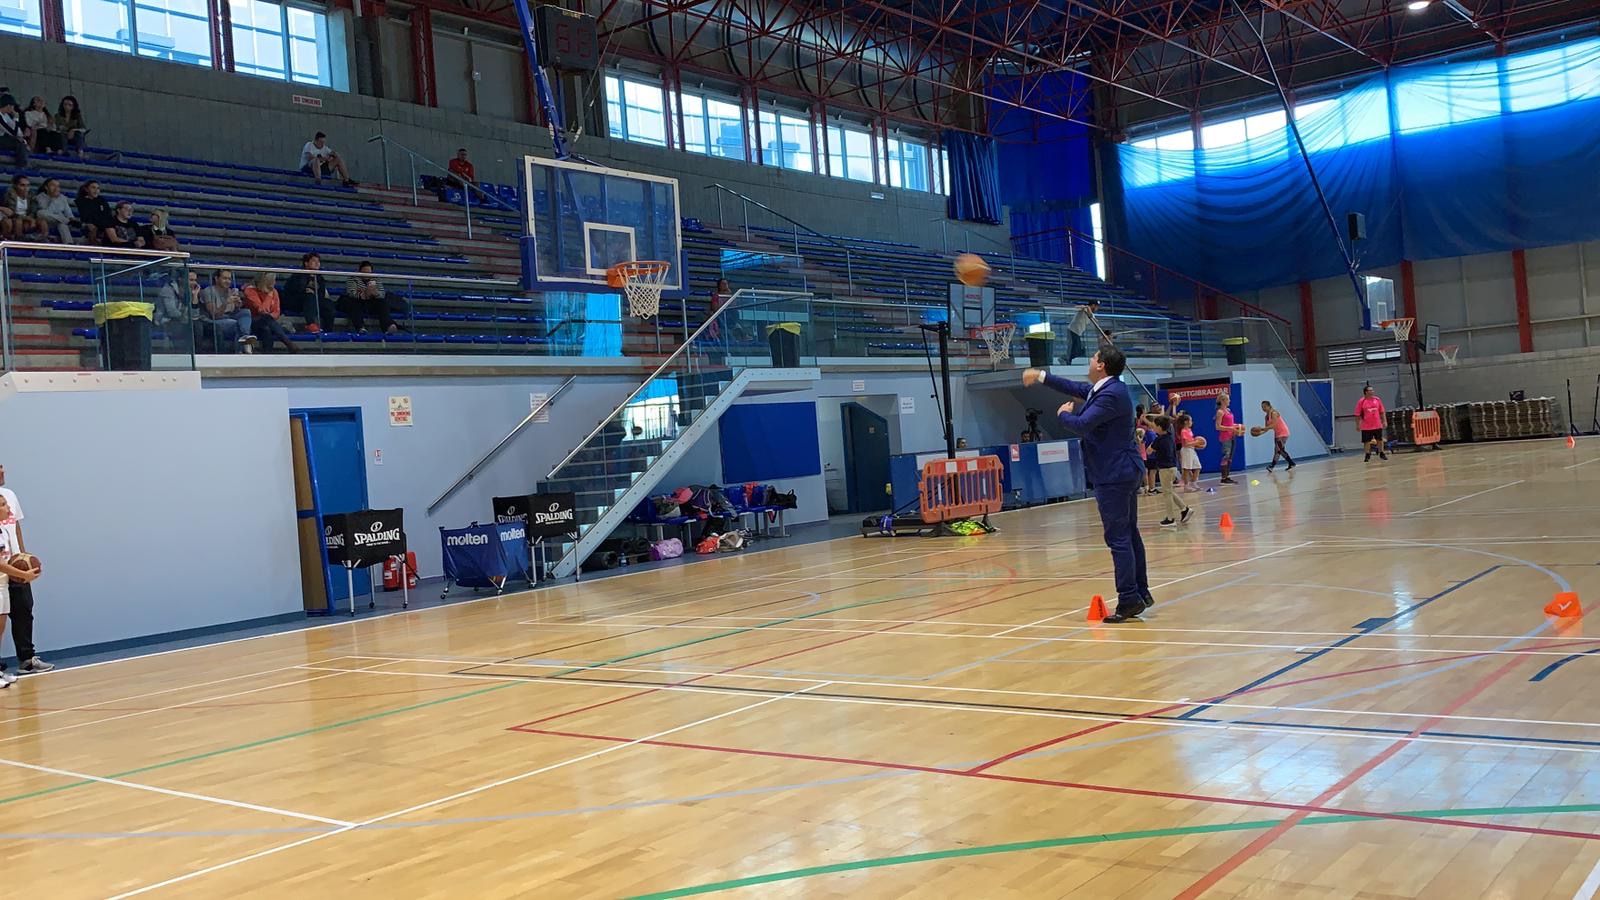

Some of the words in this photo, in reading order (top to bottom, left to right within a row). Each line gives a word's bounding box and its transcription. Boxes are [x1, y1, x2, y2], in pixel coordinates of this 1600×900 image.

[535, 508, 574, 525] SPALDING
[325, 533, 345, 547] LDING
[354, 527, 401, 546] SPALDING
[446, 533, 489, 546] molten
[500, 528, 526, 542] molten
